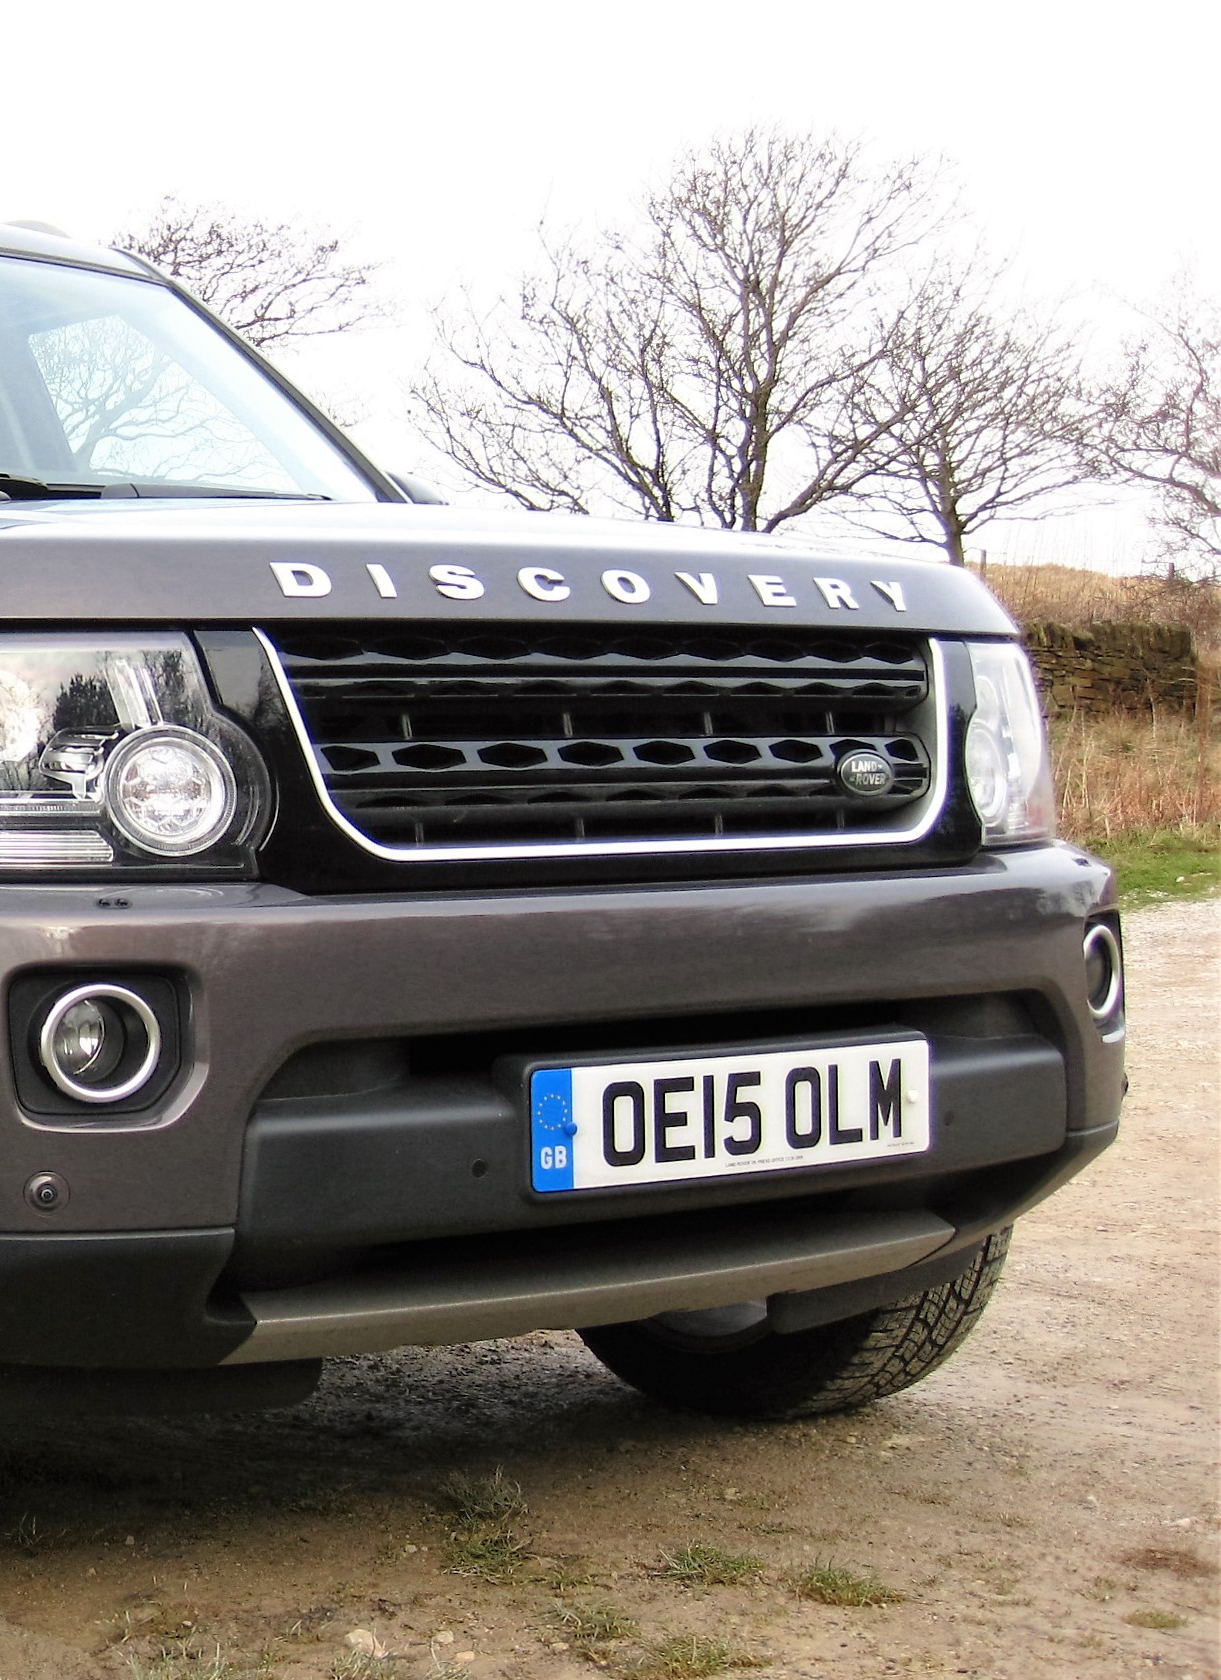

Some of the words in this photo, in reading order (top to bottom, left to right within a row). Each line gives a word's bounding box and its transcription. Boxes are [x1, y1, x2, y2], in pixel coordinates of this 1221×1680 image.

[270, 561, 908, 612] DISCOVERY
[851, 761, 877, 772] LAND
[856, 773, 886, 785] ROVER
[602, 1070, 762, 1168] OE15
[784, 1057, 903, 1150] OLM
[540, 1145, 567, 1170] GB
